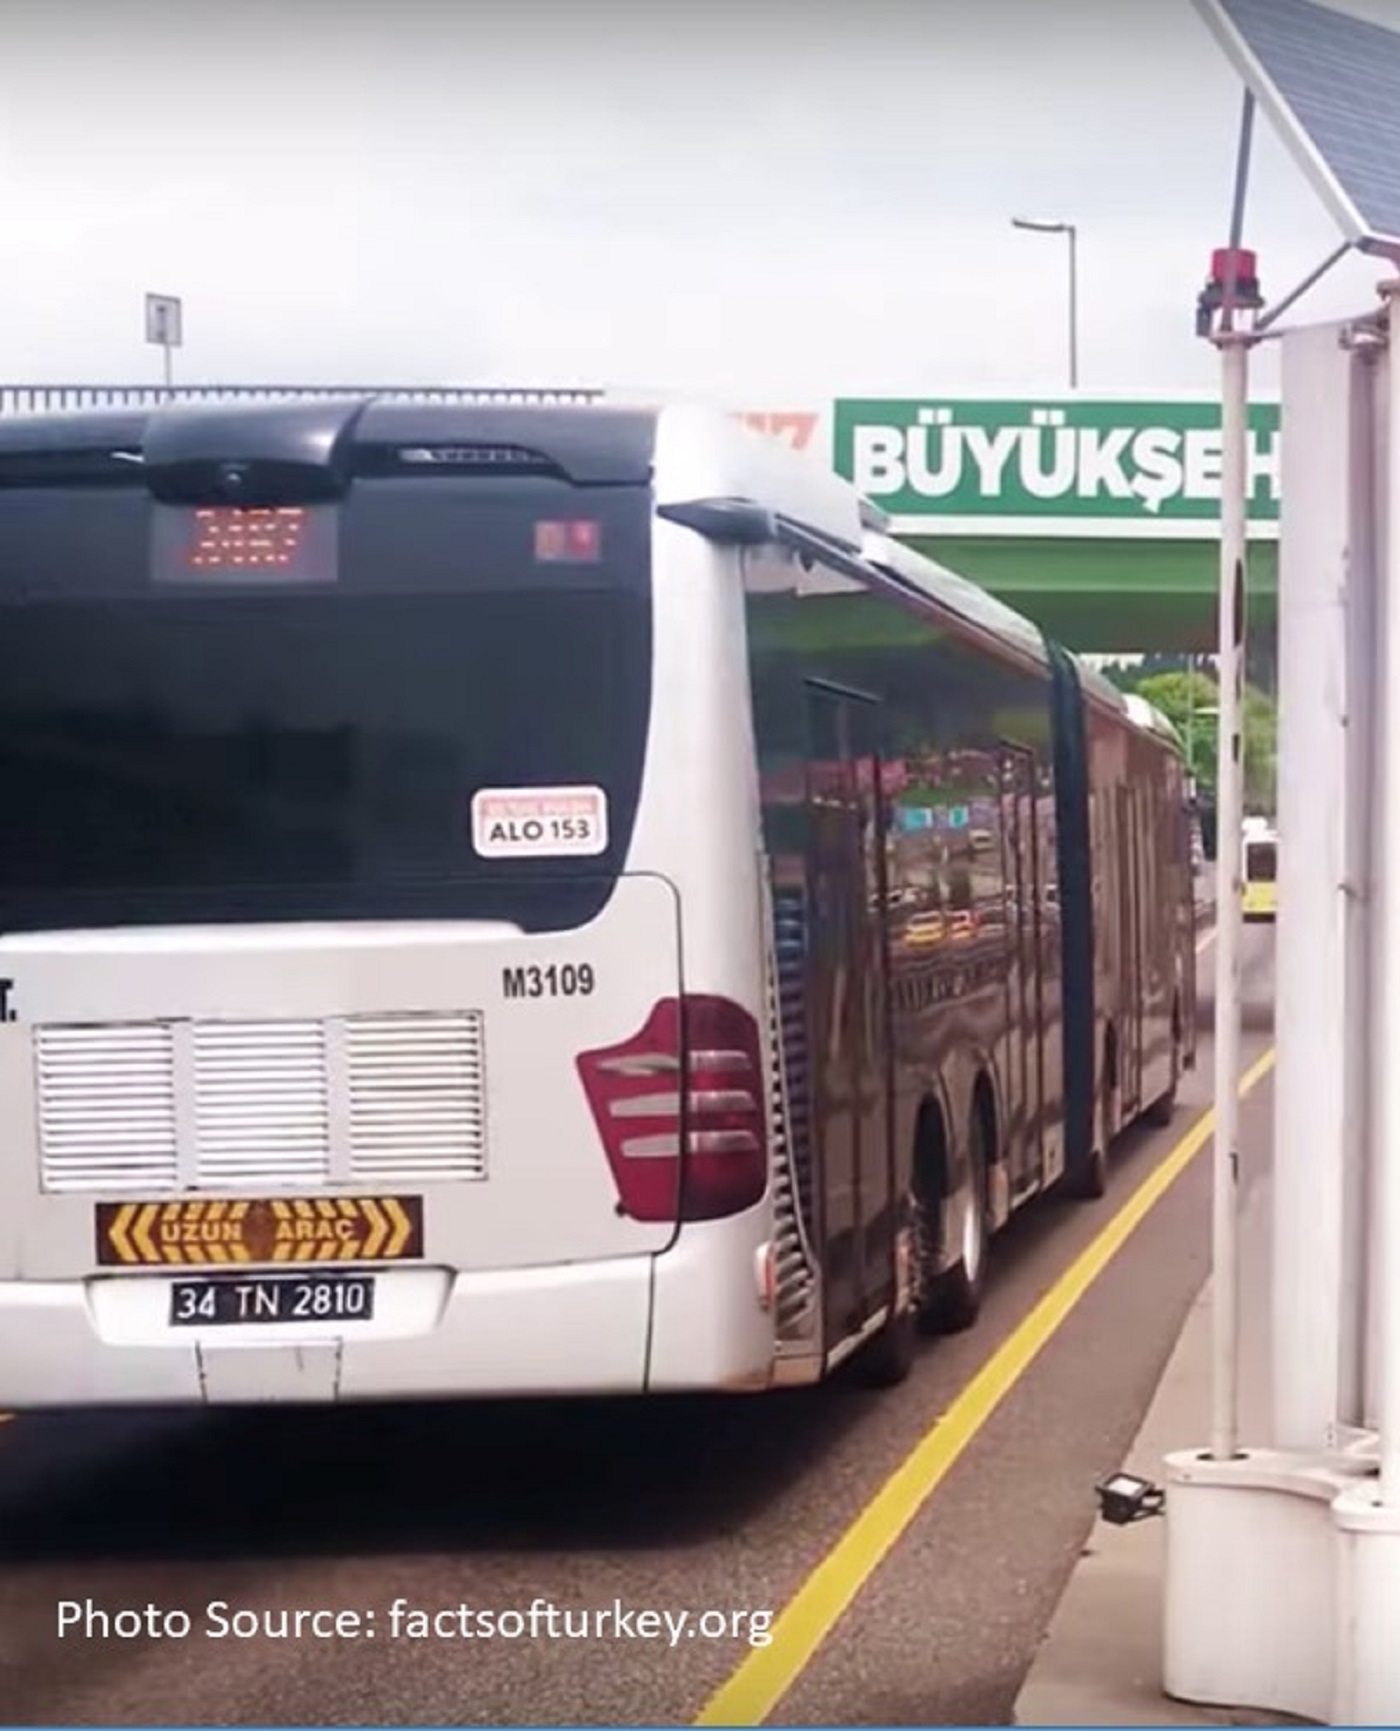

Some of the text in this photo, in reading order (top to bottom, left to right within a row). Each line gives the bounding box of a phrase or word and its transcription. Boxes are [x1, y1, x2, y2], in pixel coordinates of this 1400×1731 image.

[489, 818, 590, 842] ALO 153
[502, 963, 595, 998] M3109
[160, 1218, 354, 1242] UZUN ARAÇ
[176, 1283, 365, 1319] 34 TN 2810
